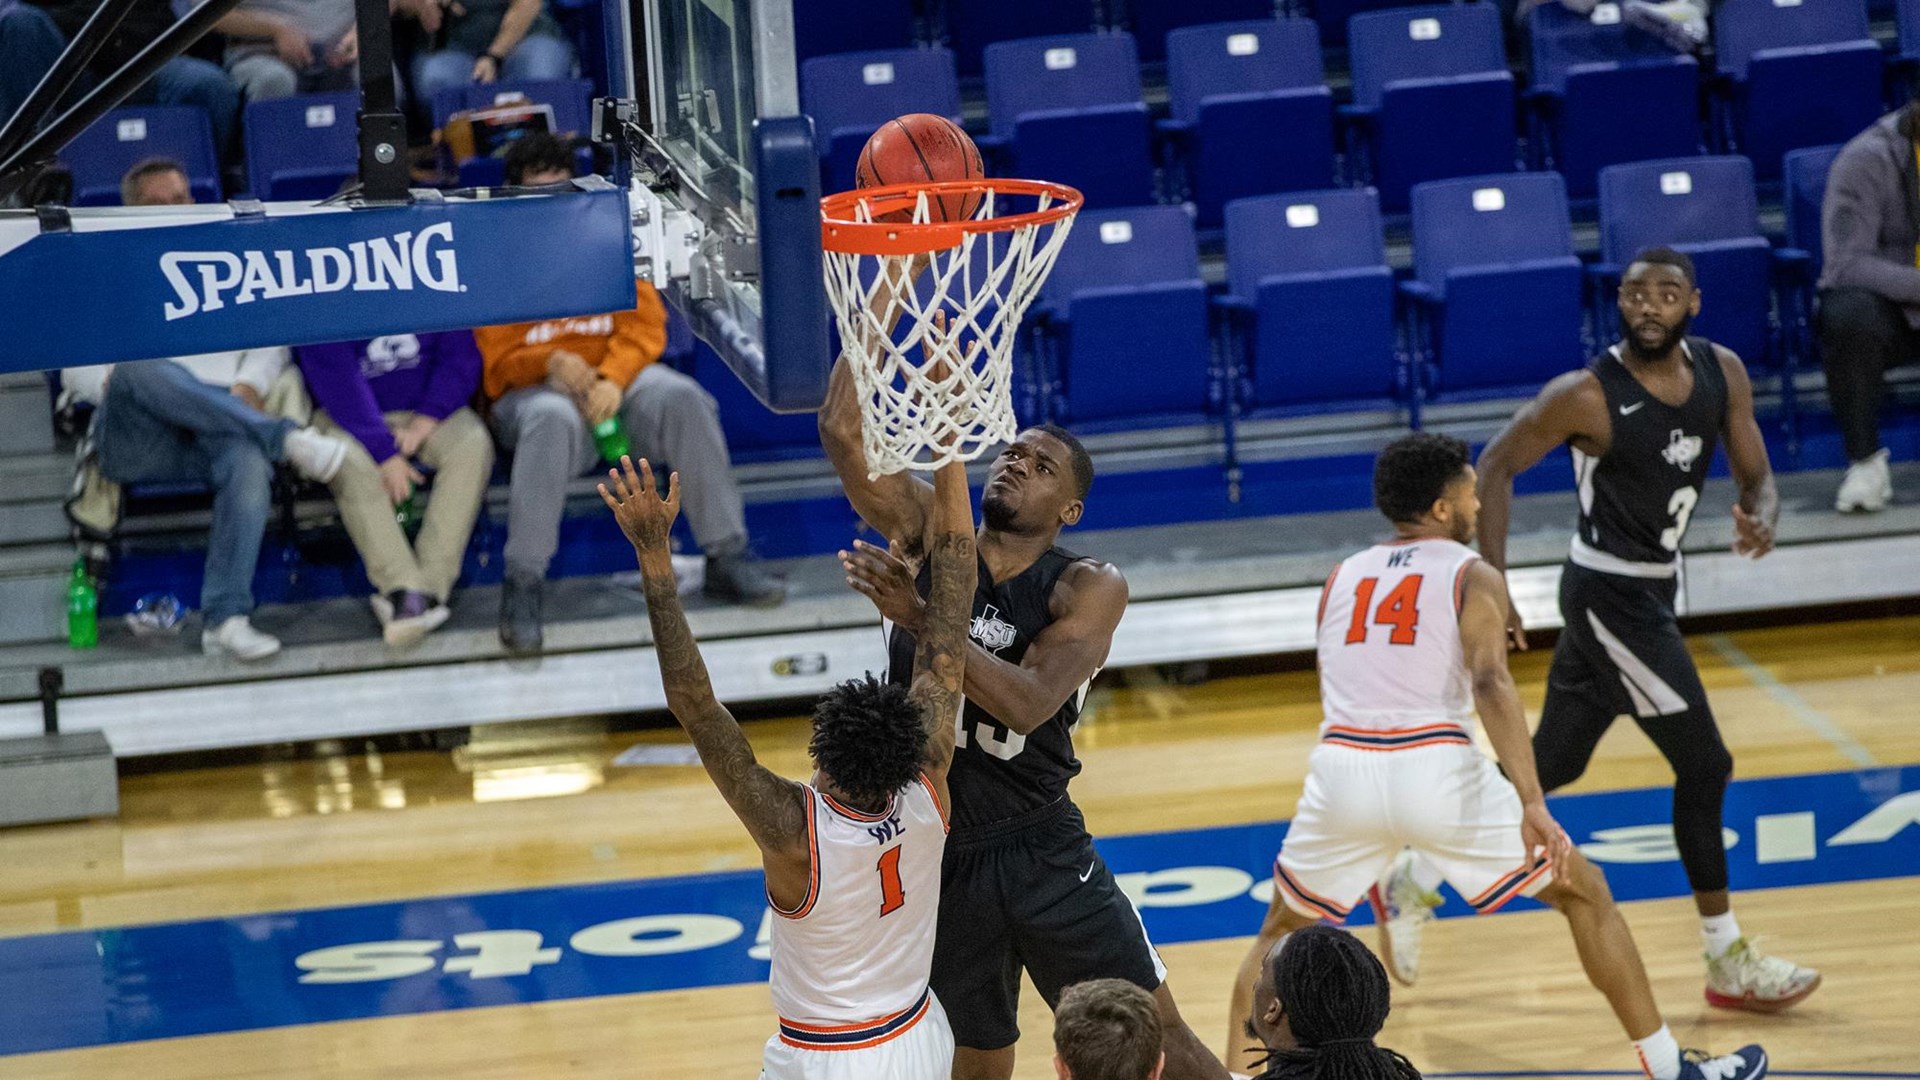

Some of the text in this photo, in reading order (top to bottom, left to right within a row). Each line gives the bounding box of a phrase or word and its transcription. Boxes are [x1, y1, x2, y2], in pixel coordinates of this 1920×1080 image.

[1659, 485, 1698, 552] 3
[1387, 547, 1420, 568] WE
[971, 616, 1017, 647] MSU
[1344, 573, 1424, 646] 14
[867, 811, 906, 846] WE
[876, 843, 905, 919] 1
